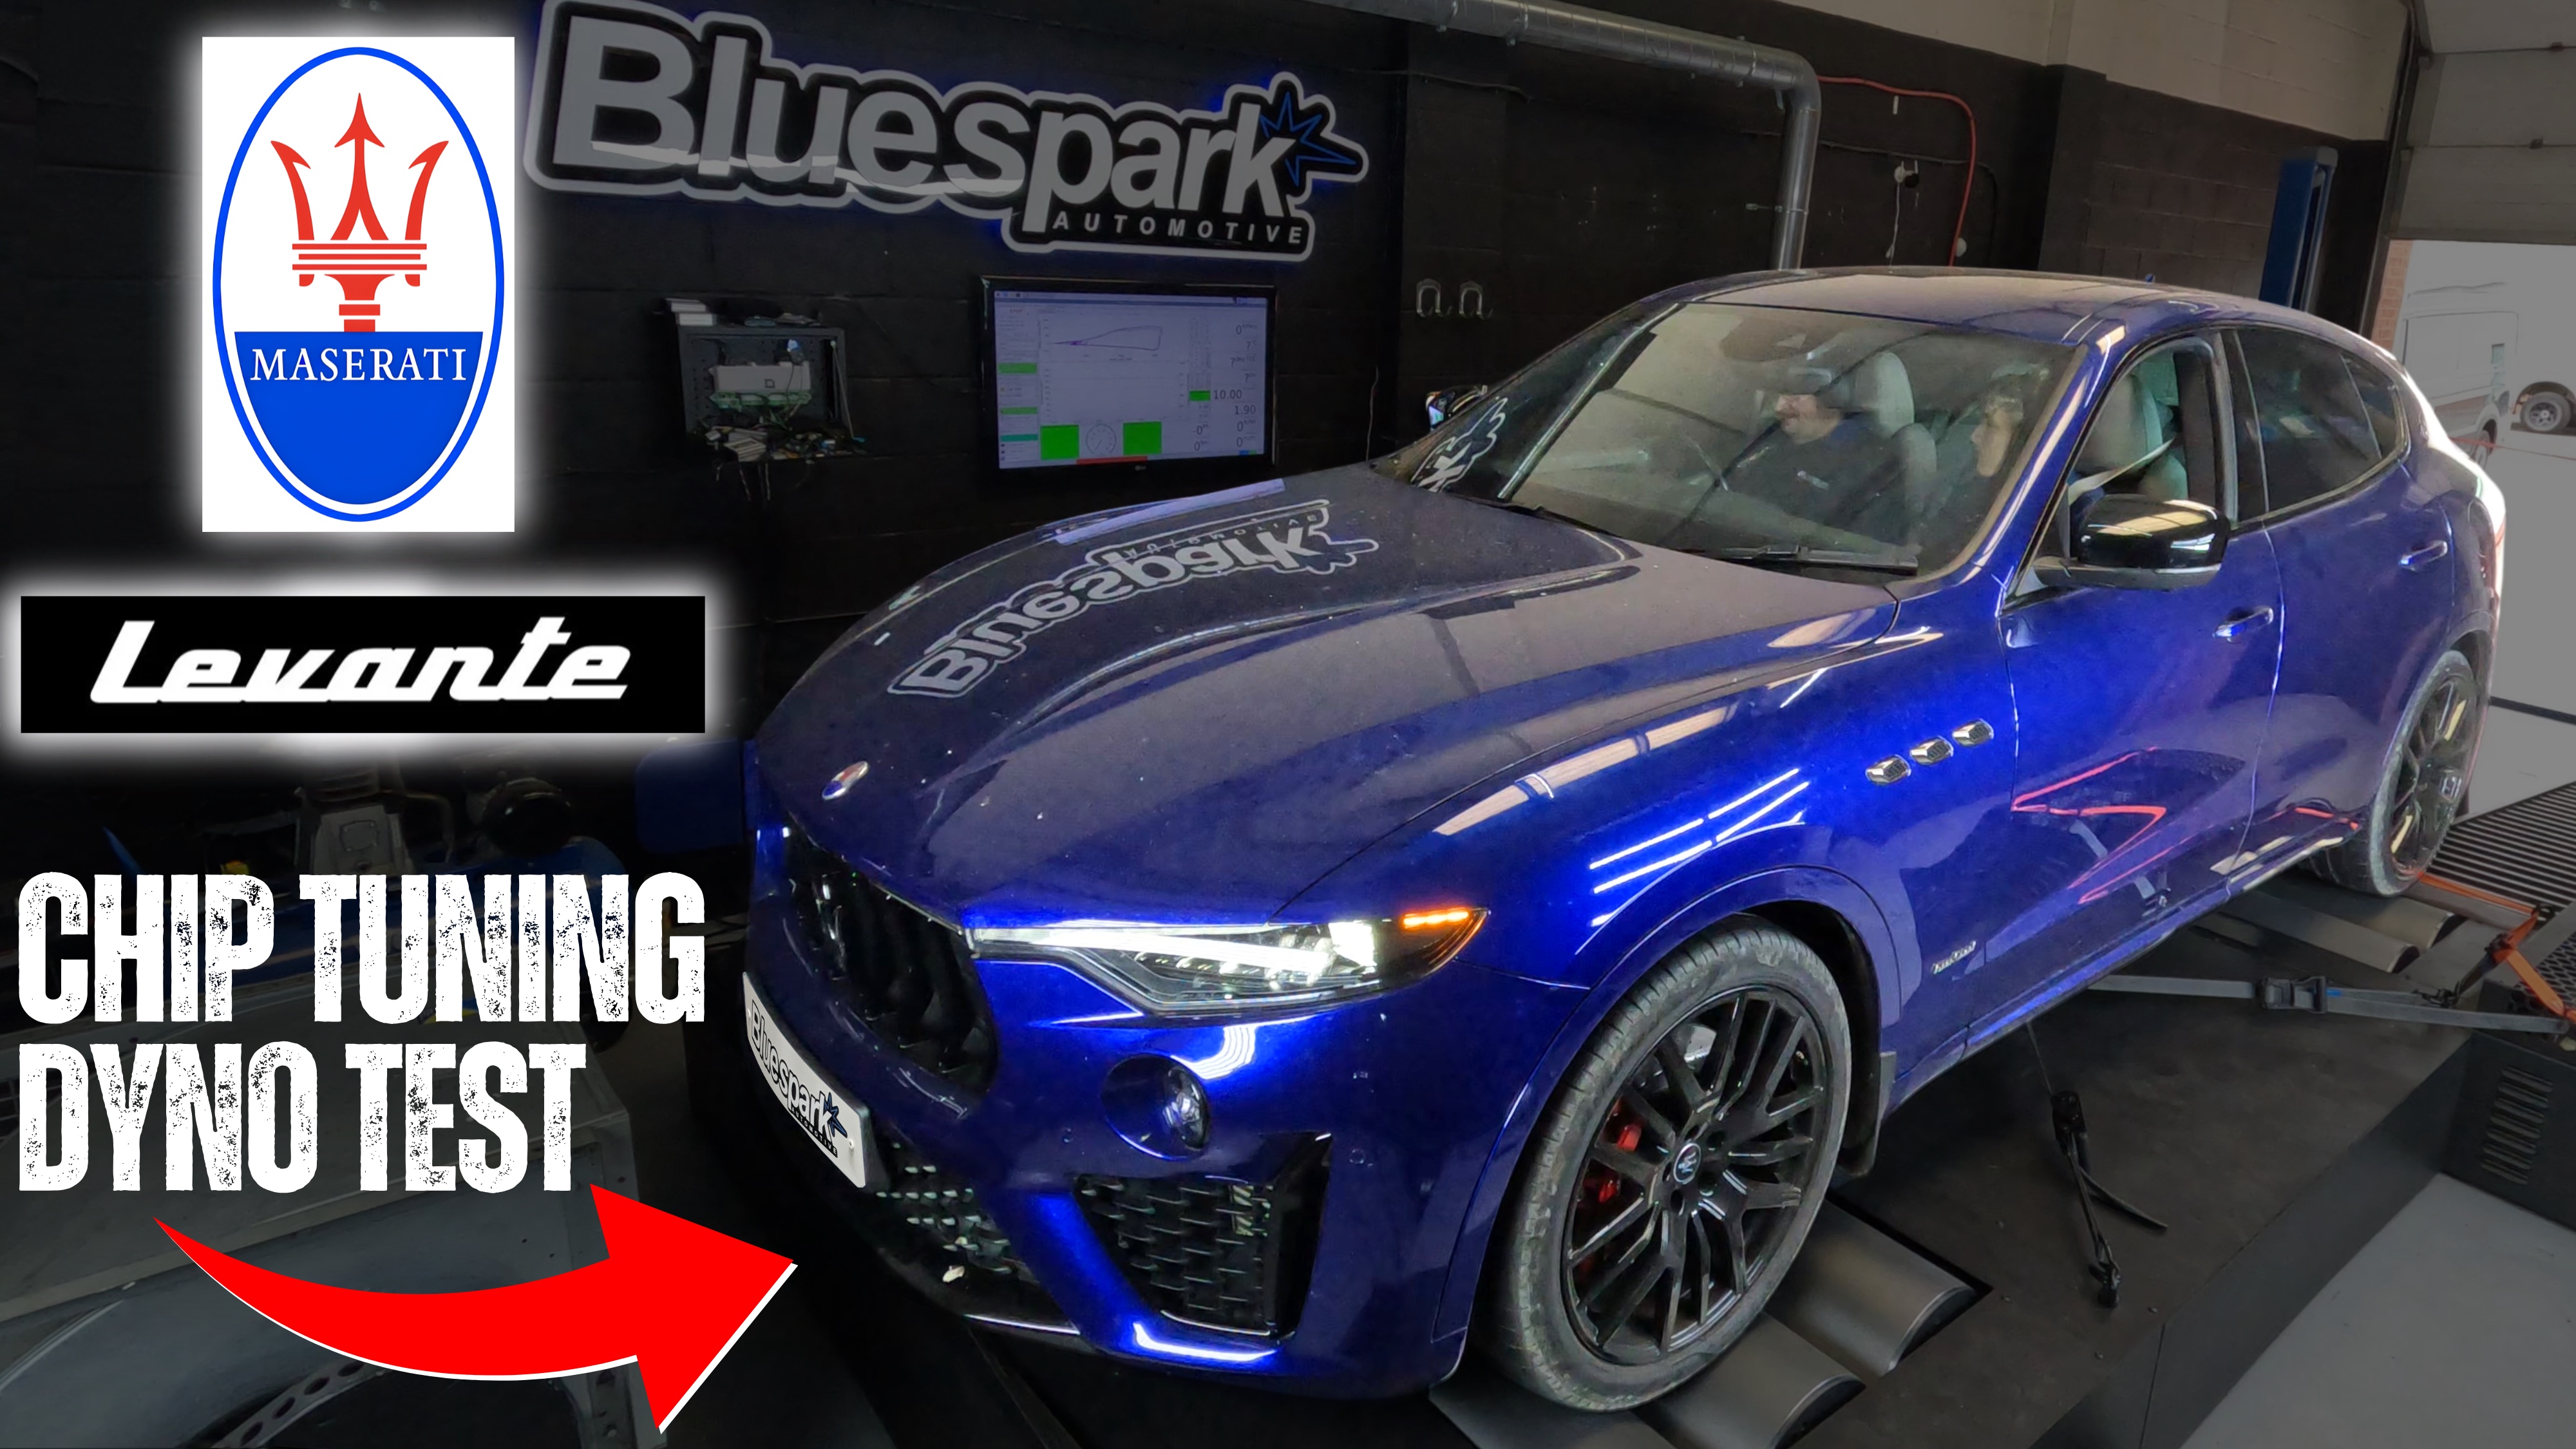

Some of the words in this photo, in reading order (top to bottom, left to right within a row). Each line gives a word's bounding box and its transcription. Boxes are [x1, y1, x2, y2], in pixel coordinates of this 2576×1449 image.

[552, 15, 1296, 232] Bluespark
[1052, 210, 1303, 245] AUTOMOTIVE
[1213, 389, 1242, 400] 10.00
[1235, 404, 1256, 415] 1.90
[751, 999, 833, 1142] Bluespark
[791, 1106, 837, 1155] AUTOMOTIVE
